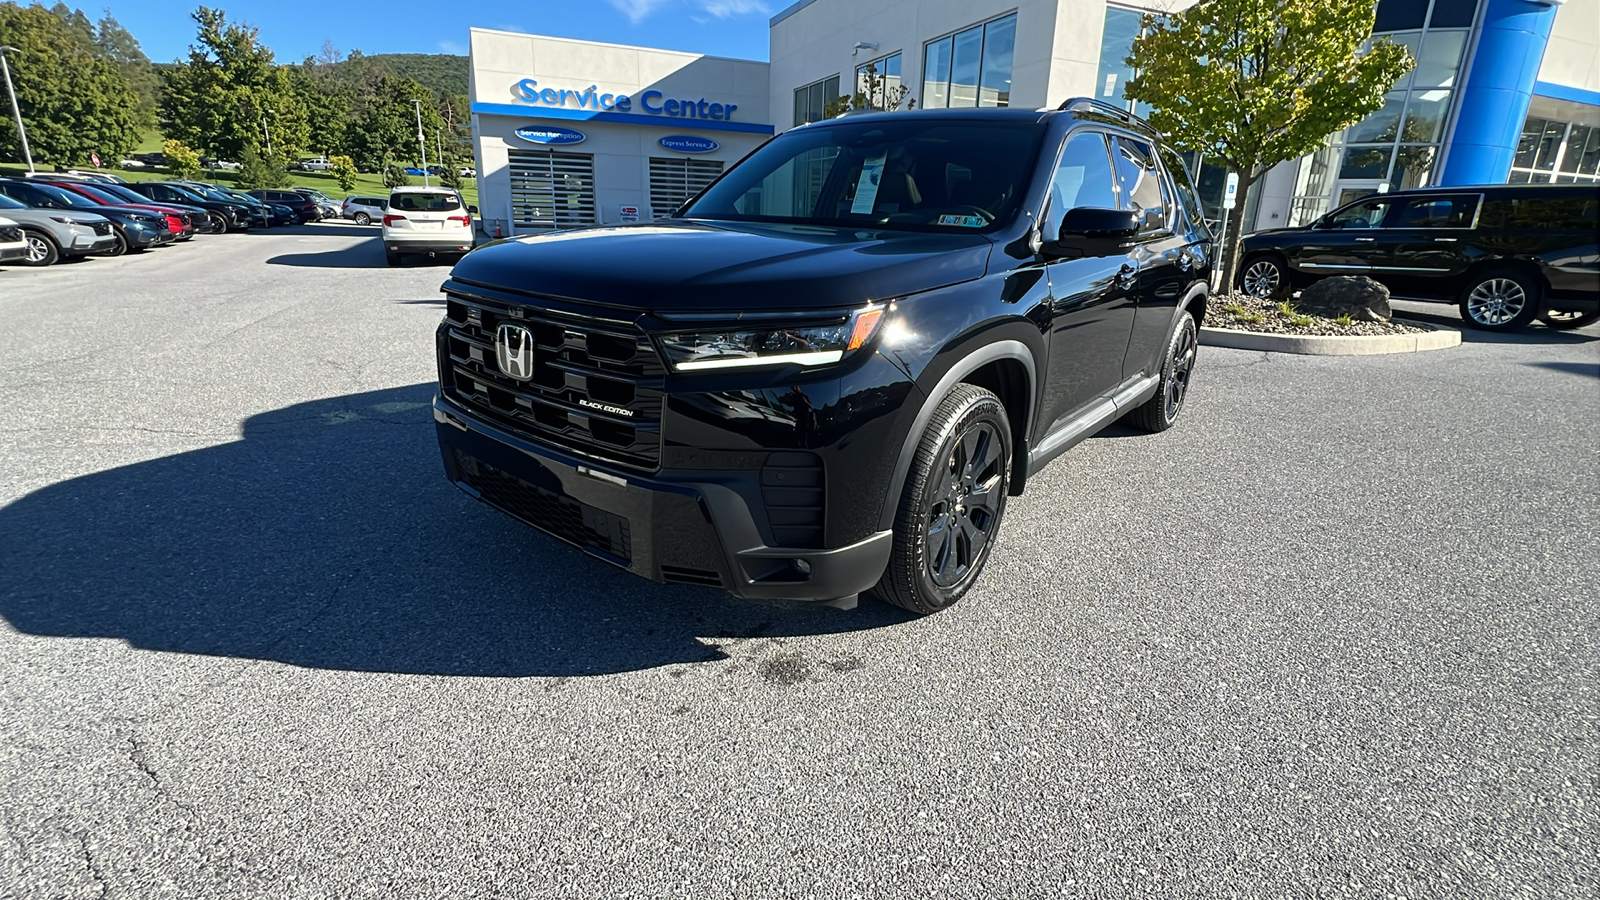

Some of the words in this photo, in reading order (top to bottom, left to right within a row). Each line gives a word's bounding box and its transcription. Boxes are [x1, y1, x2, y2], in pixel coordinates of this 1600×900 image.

[518, 78, 632, 112] Service
[641, 90, 738, 120] Center
[520, 129, 547, 137] Service
[547, 131, 582, 140] Reception
[661, 139, 685, 147] Express
[685, 140, 707, 148] Service
[579, 399, 604, 410] BLACK
[603, 405, 634, 417] EDITION
